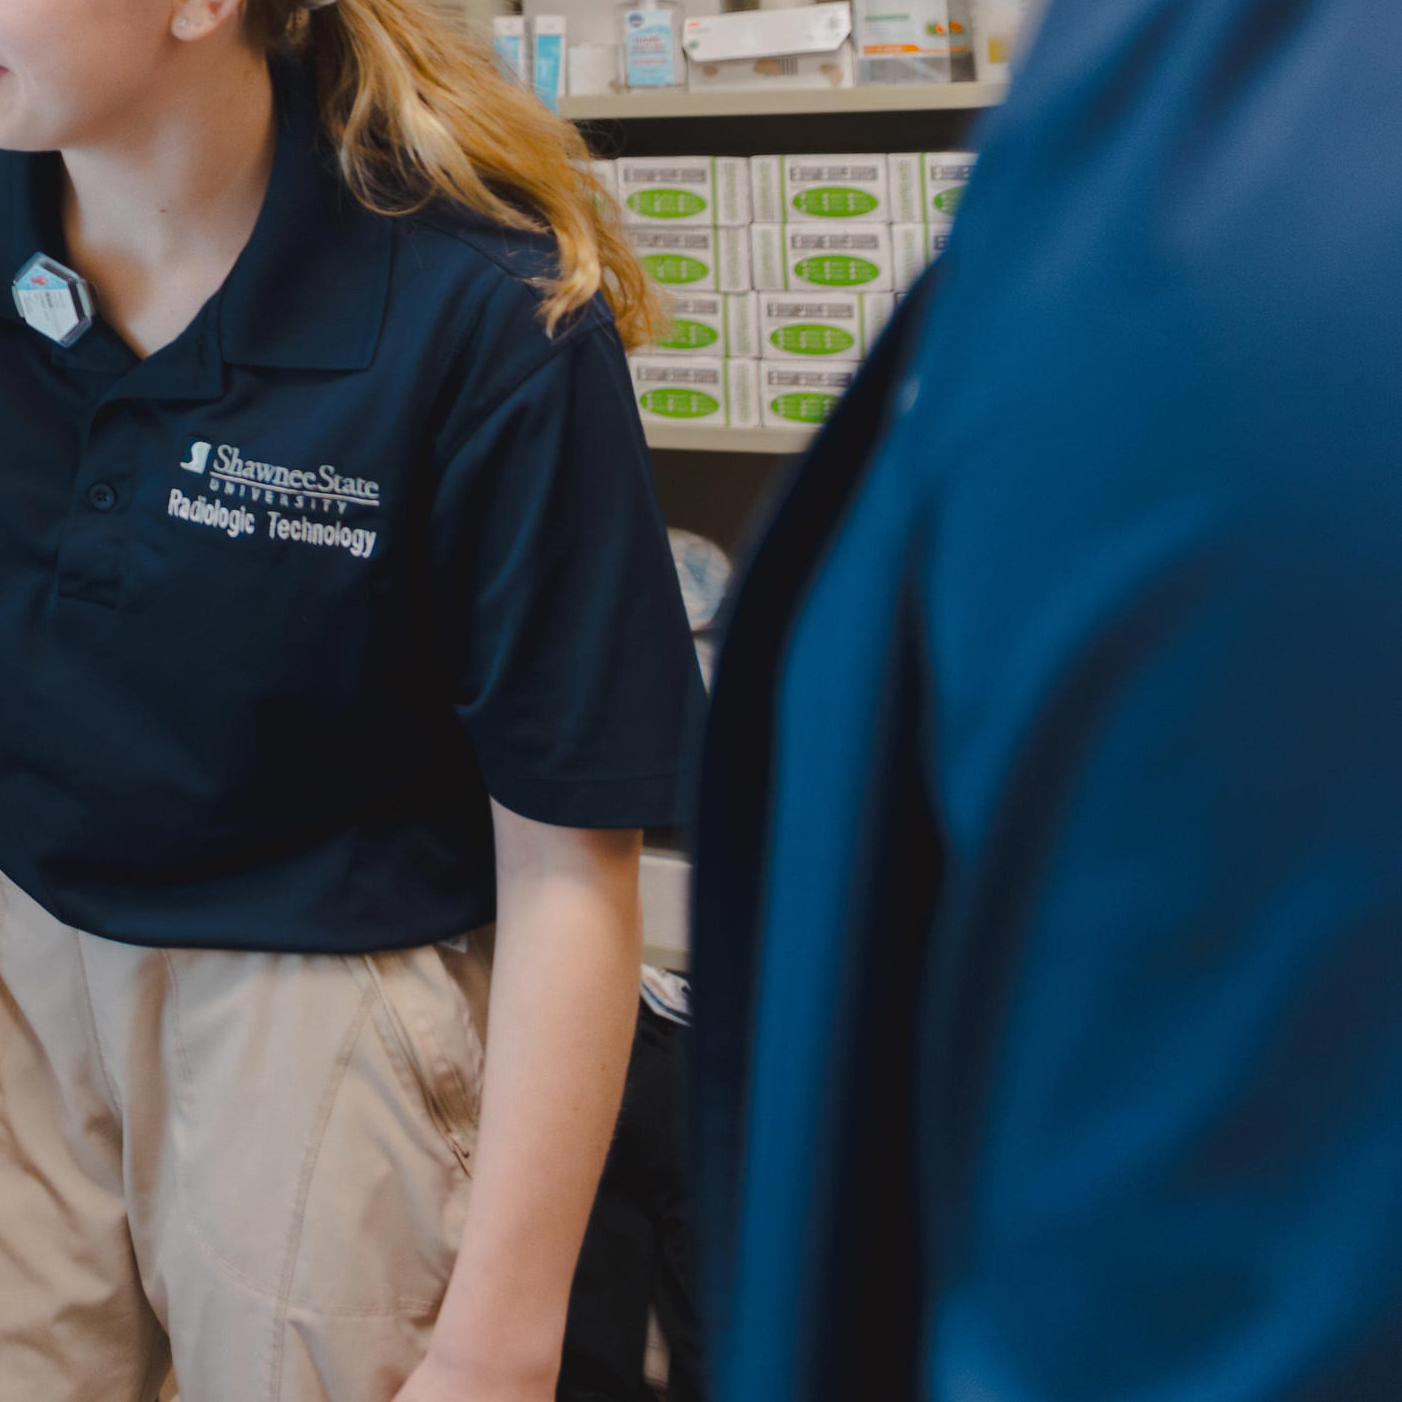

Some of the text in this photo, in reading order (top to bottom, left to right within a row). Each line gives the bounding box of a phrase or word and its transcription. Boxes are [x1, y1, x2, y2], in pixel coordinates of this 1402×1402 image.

[209, 478, 347, 515] UNIVERSITY
[212, 444, 379, 497] Shawnee State
[167, 488, 377, 559] Radiologic Technology
